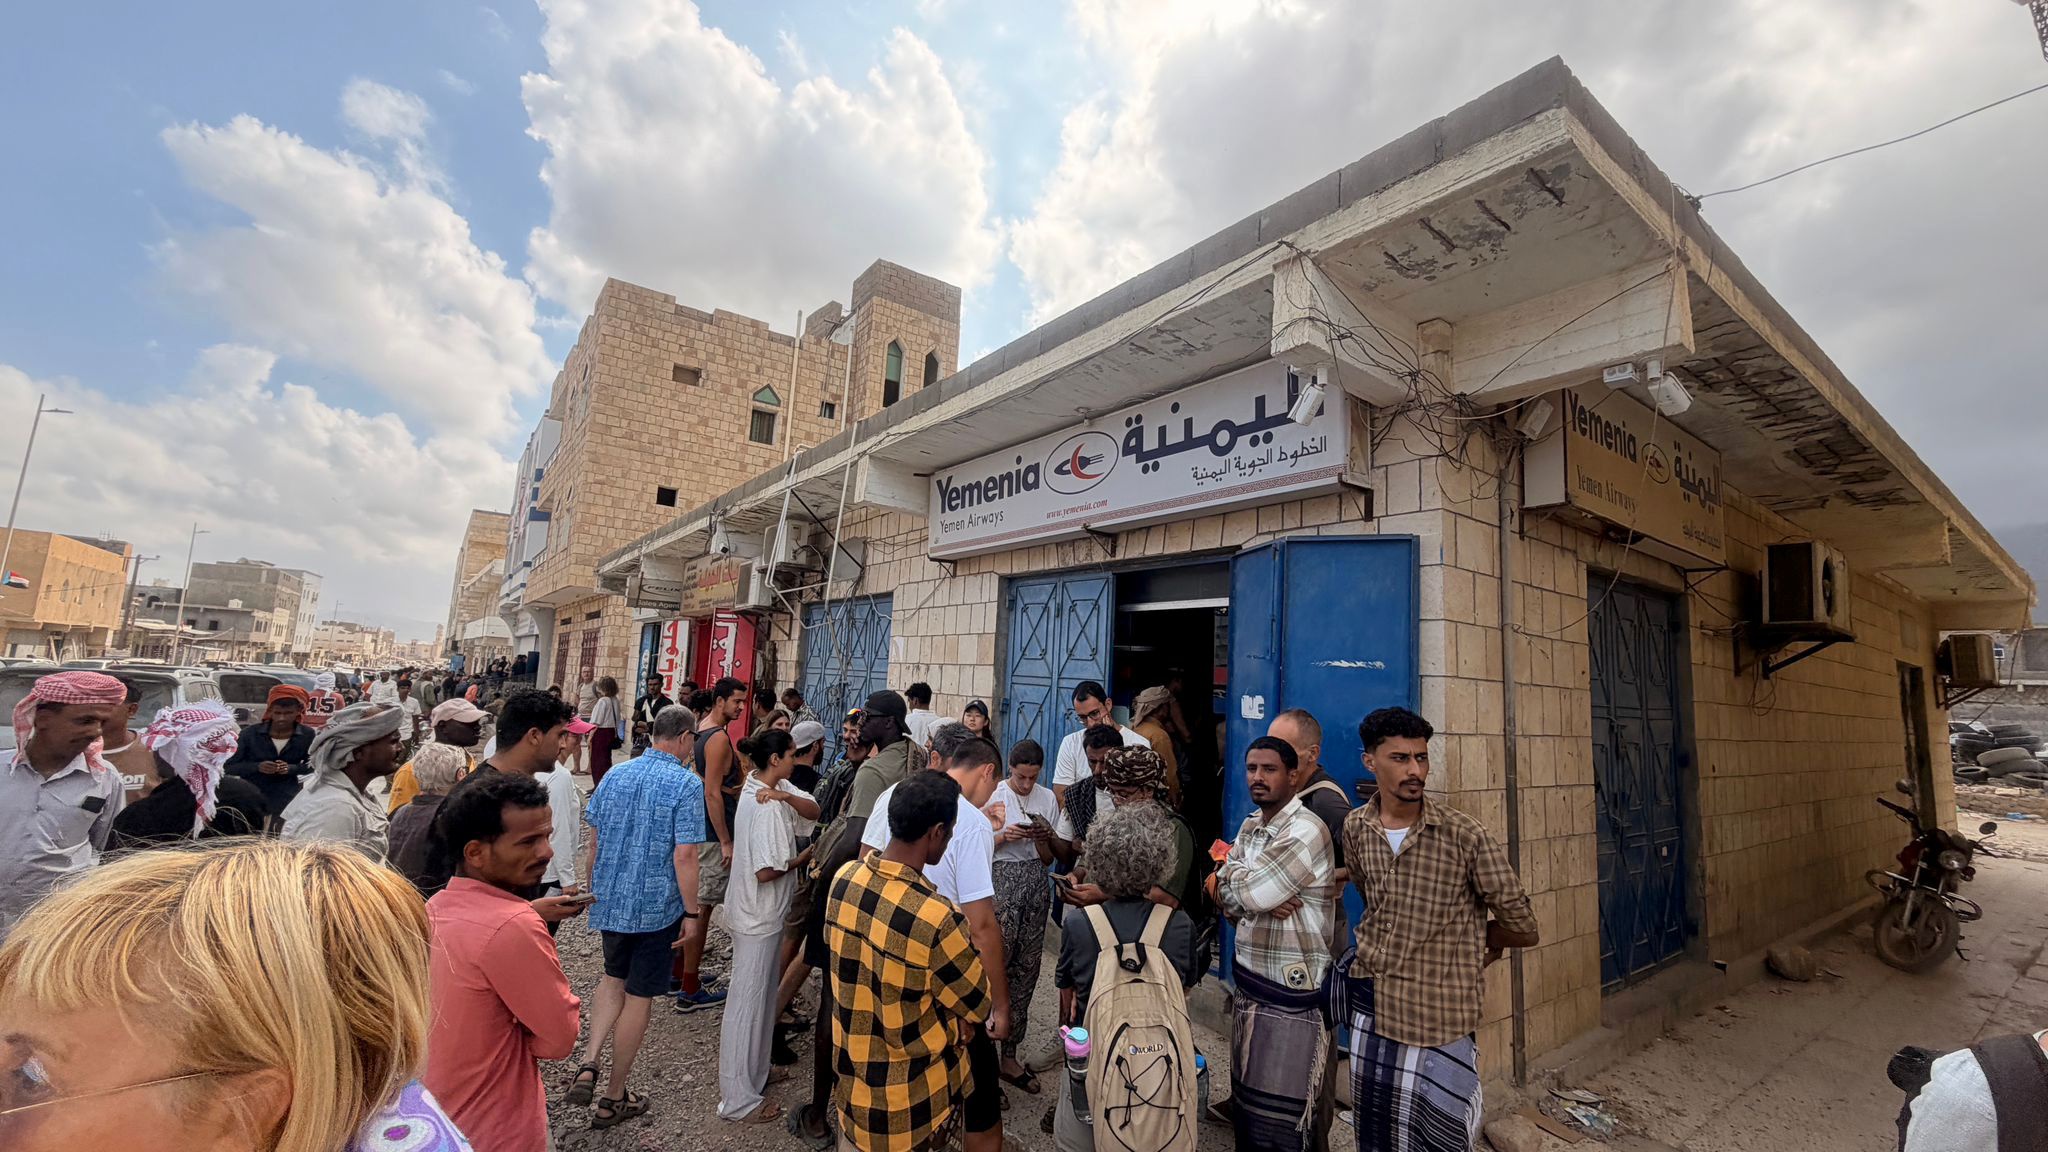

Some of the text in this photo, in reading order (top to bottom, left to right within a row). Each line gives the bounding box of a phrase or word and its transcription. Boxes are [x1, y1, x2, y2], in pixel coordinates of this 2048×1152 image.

[1567, 388, 1637, 464] Yemenia
[936, 455, 1040, 514] Yemenia
[1191, 435, 1327, 486] الخطوط الجوية اليمنية
[1674, 440, 1721, 516] اليمنية
[1046, 499, 1108, 519] www.yemenia.com
[1576, 464, 1637, 517] Yemen Airways
[940, 510, 1004, 534] Yemen Airways
[306, 696, 336, 715] 15
[1136, 1043, 1164, 1055] WORLD
